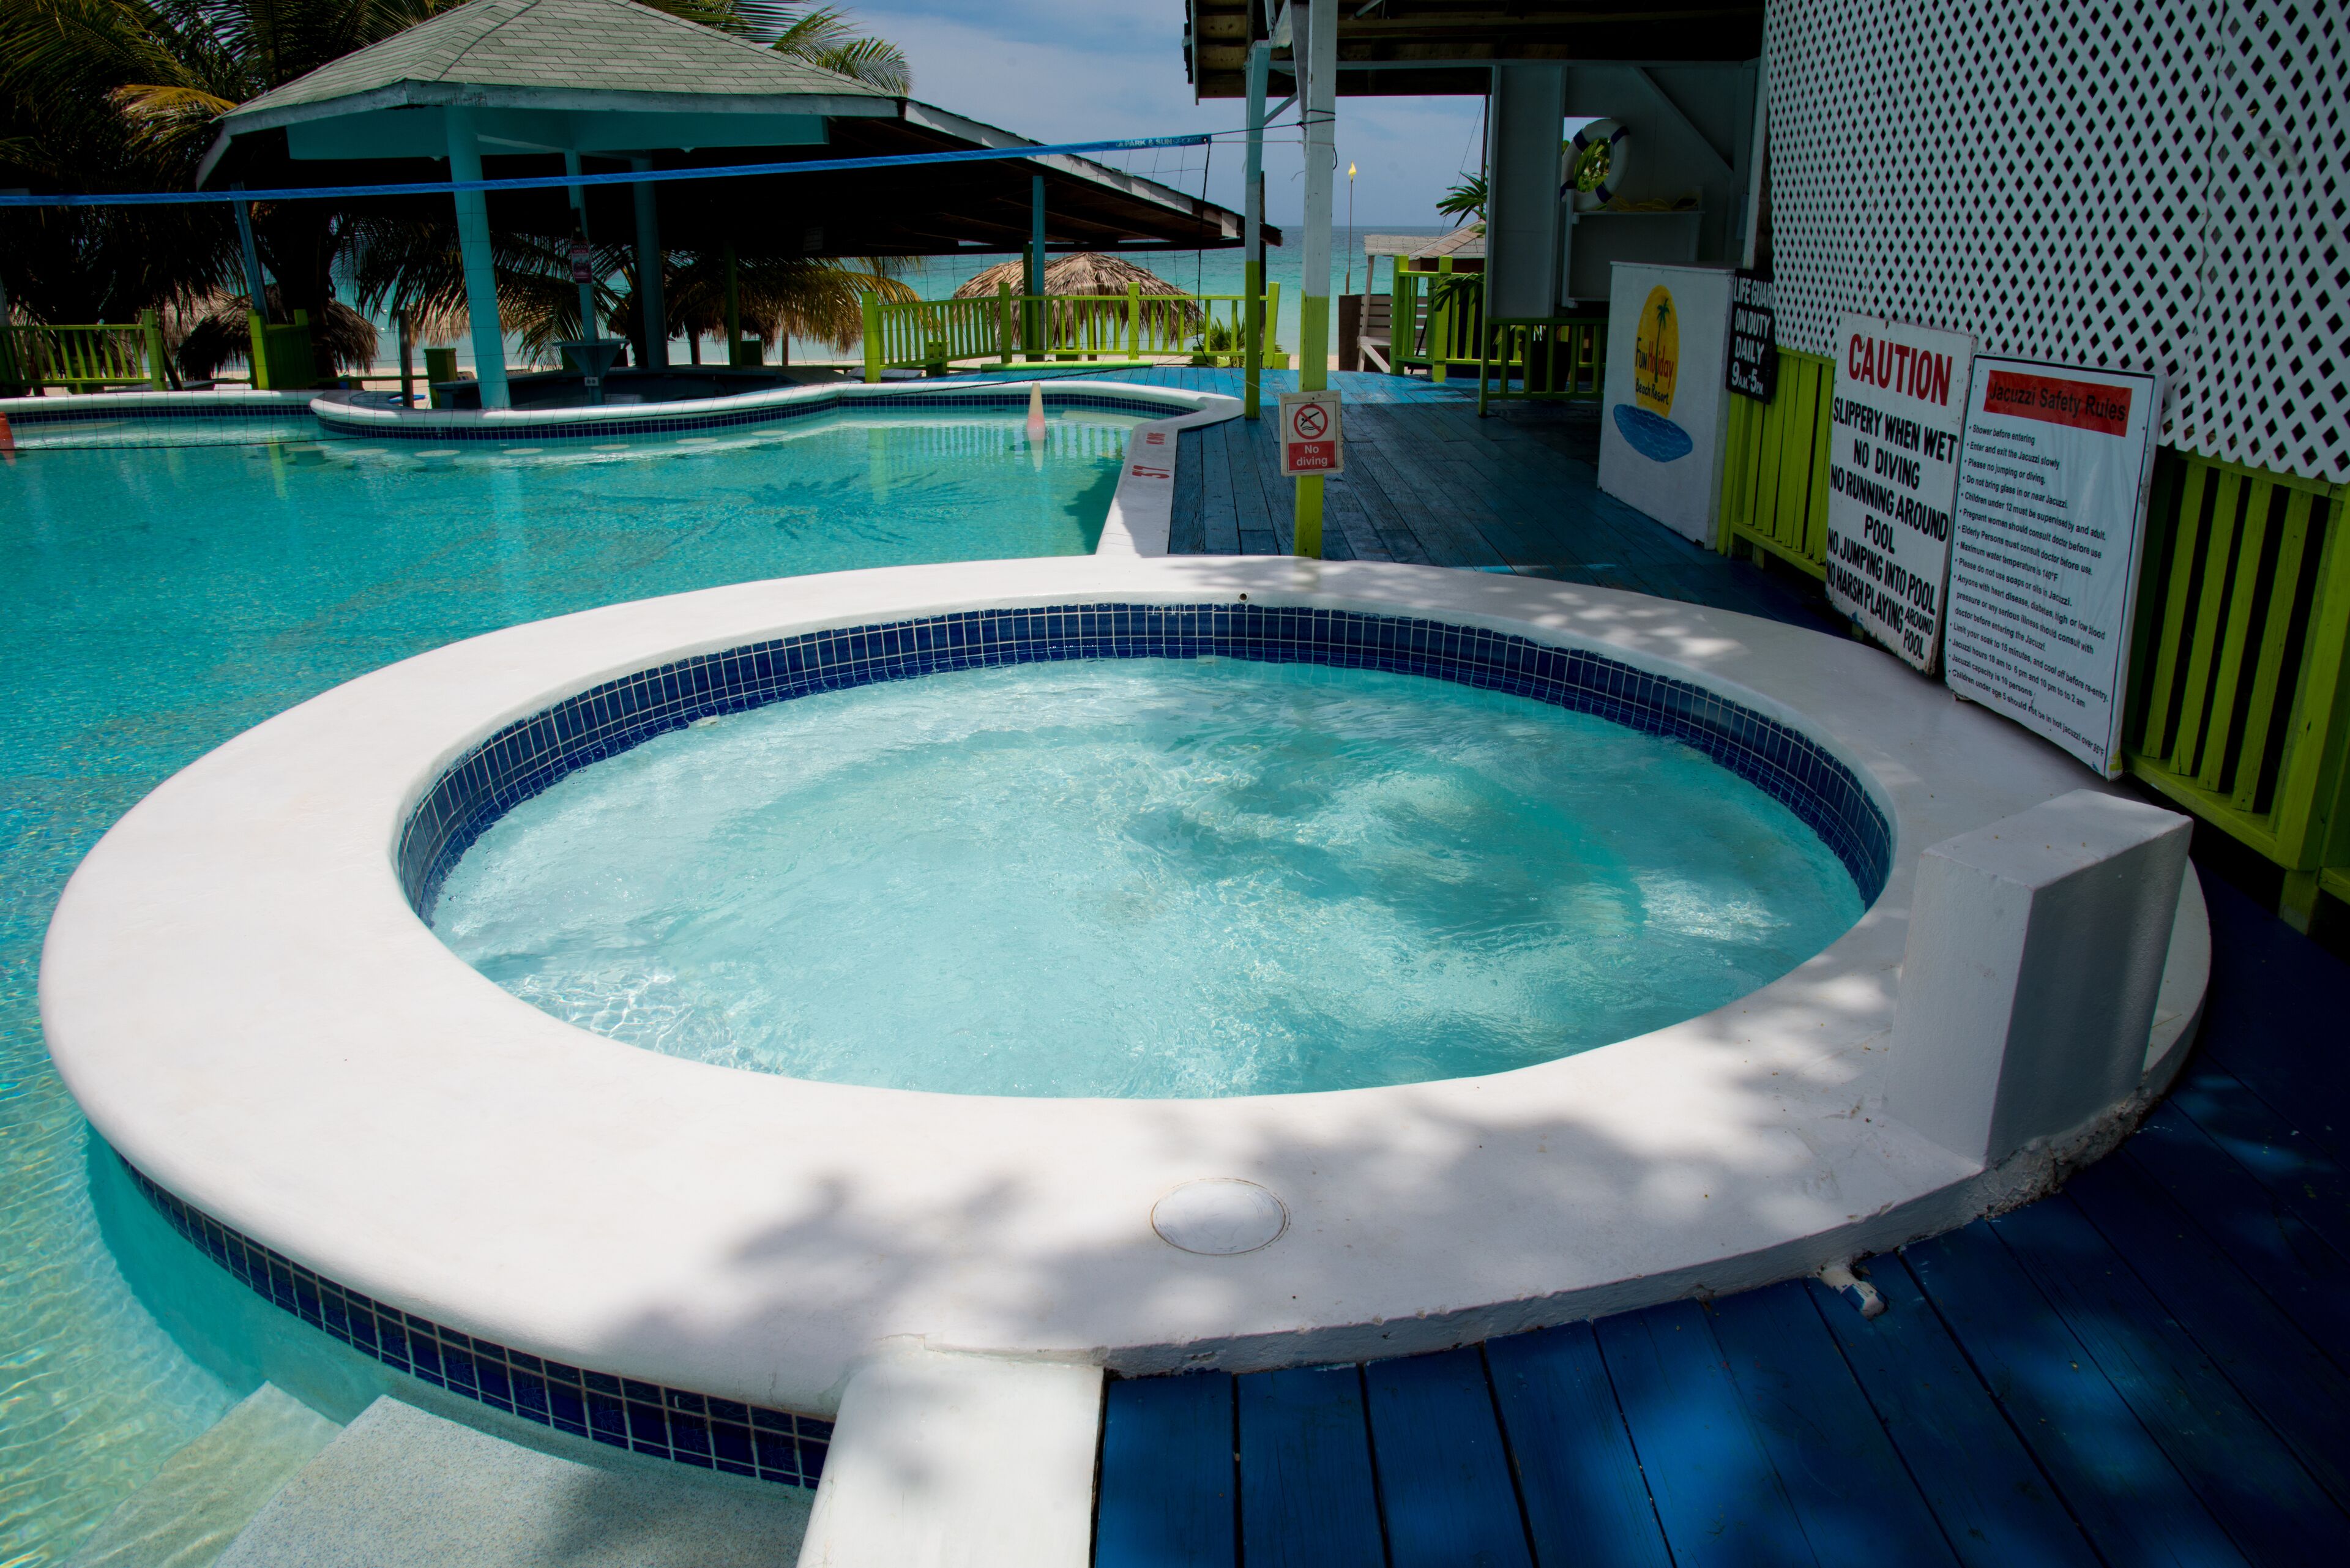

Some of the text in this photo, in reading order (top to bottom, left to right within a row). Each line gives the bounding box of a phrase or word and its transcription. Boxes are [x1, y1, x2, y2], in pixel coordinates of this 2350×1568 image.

[1734, 276, 1751, 304] LIFE
[1735, 307, 1770, 339] ON DUTY
[1734, 335, 1765, 365] DAILY
[1849, 333, 1952, 406] CAUTION
[1636, 377, 1669, 405] Beach Resort
[1989, 382, 2126, 422] Jacuzzi Safety Rules
[1304, 445, 1319, 454] No
[1833, 397, 1958, 464] SLIPPERY WHEN WET
[1972, 424, 2035, 446] Shower before entering
[1296, 456, 1327, 467] diving
[1854, 438, 1920, 490] NO DIVING
[1968, 458, 1986, 469] Please
[1995, 465, 2017, 479] jumping
[2026, 471, 2046, 484] diving.
[1970, 442, 2060, 470] Enter and exit the Jacuzzi slowly
[1830, 464, 1949, 542] NO RUNNING AROUND
[1965, 491, 2106, 540] Children under 12 must be supervised by and adult.
[1975, 479, 1984, 487] not
[1985, 480, 1999, 492] bring
[2000, 484, 2015, 495] glass
[2017, 487, 2022, 496] in
[2031, 491, 2045, 502] near
[2046, 495, 2068, 509] Jacuzzi.
[1865, 514, 1895, 554] POOL
[1962, 525, 2092, 575] Elderly Persons must consult doctor before use.
[1963, 509, 2102, 558] Pregnant women should consult doctor before use
[1827, 528, 1935, 615] NO JUMPING INTO POOL
[1960, 541, 1985, 556] Maximum
[1986, 551, 2001, 561] water
[2002, 556, 2035, 573] temperature
[2037, 566, 2041, 575] is
[1826, 559, 1933, 635] NO HARSH PLAYING AROUND
[1959, 558, 1976, 570] Please
[1977, 563, 1984, 572] do
[1985, 567, 1994, 577] not
[1996, 571, 2005, 580] use
[2006, 575, 2024, 588] soaps
[2032, 583, 2042, 593] oils
[2043, 588, 2048, 597] in
[2048, 590, 2072, 607] Jacuzzi.
[1955, 607, 2046, 651] doctor before entering the Jacuzzi.
[1956, 592, 1980, 606] pressure
[1988, 603, 1997, 614] any
[1999, 607, 2020, 622] serious
[2021, 613, 2039, 629] illness
[2040, 622, 2056, 638] should
[2058, 631, 2080, 648] consult
[2081, 641, 2094, 655] with
[1957, 575, 1978, 589] Anyone
[1979, 580, 1990, 592] with
[1991, 585, 2004, 598] heart
[2005, 591, 2029, 609] disease,
[2031, 601, 2053, 618] diabetes,
[2054, 613, 2067, 625] high
[2078, 620, 2088, 632] low
[2089, 625, 2105, 640] blood
[1903, 629, 1923, 660] POOL
[1953, 620, 1966, 635] Limit
[1967, 628, 1979, 641] your
[1980, 632, 1993, 645] soak
[1994, 639, 2000, 648] to
[2001, 642, 2007, 652] 15
[2009, 645, 2032, 664] minutes,
[2033, 657, 2043, 670] and
[2044, 662, 2056, 675] cool
[2066, 671, 2084, 689] before
[2085, 681, 2108, 703] re-entry.
[1952, 654, 2032, 696] Jacuzzi capacity is 10 persons
[1952, 668, 1974, 685] Children
[1975, 681, 1991, 694] under
[1992, 689, 2001, 699] age
[2007, 695, 2027, 711] should
[2028, 705, 2037, 715] not
[2038, 710, 2045, 720] be
[2046, 714, 2051, 723] in
[2053, 717, 2062, 730] hot
[2062, 723, 2081, 741] jacuzzi
[2081, 736, 2093, 749] over
